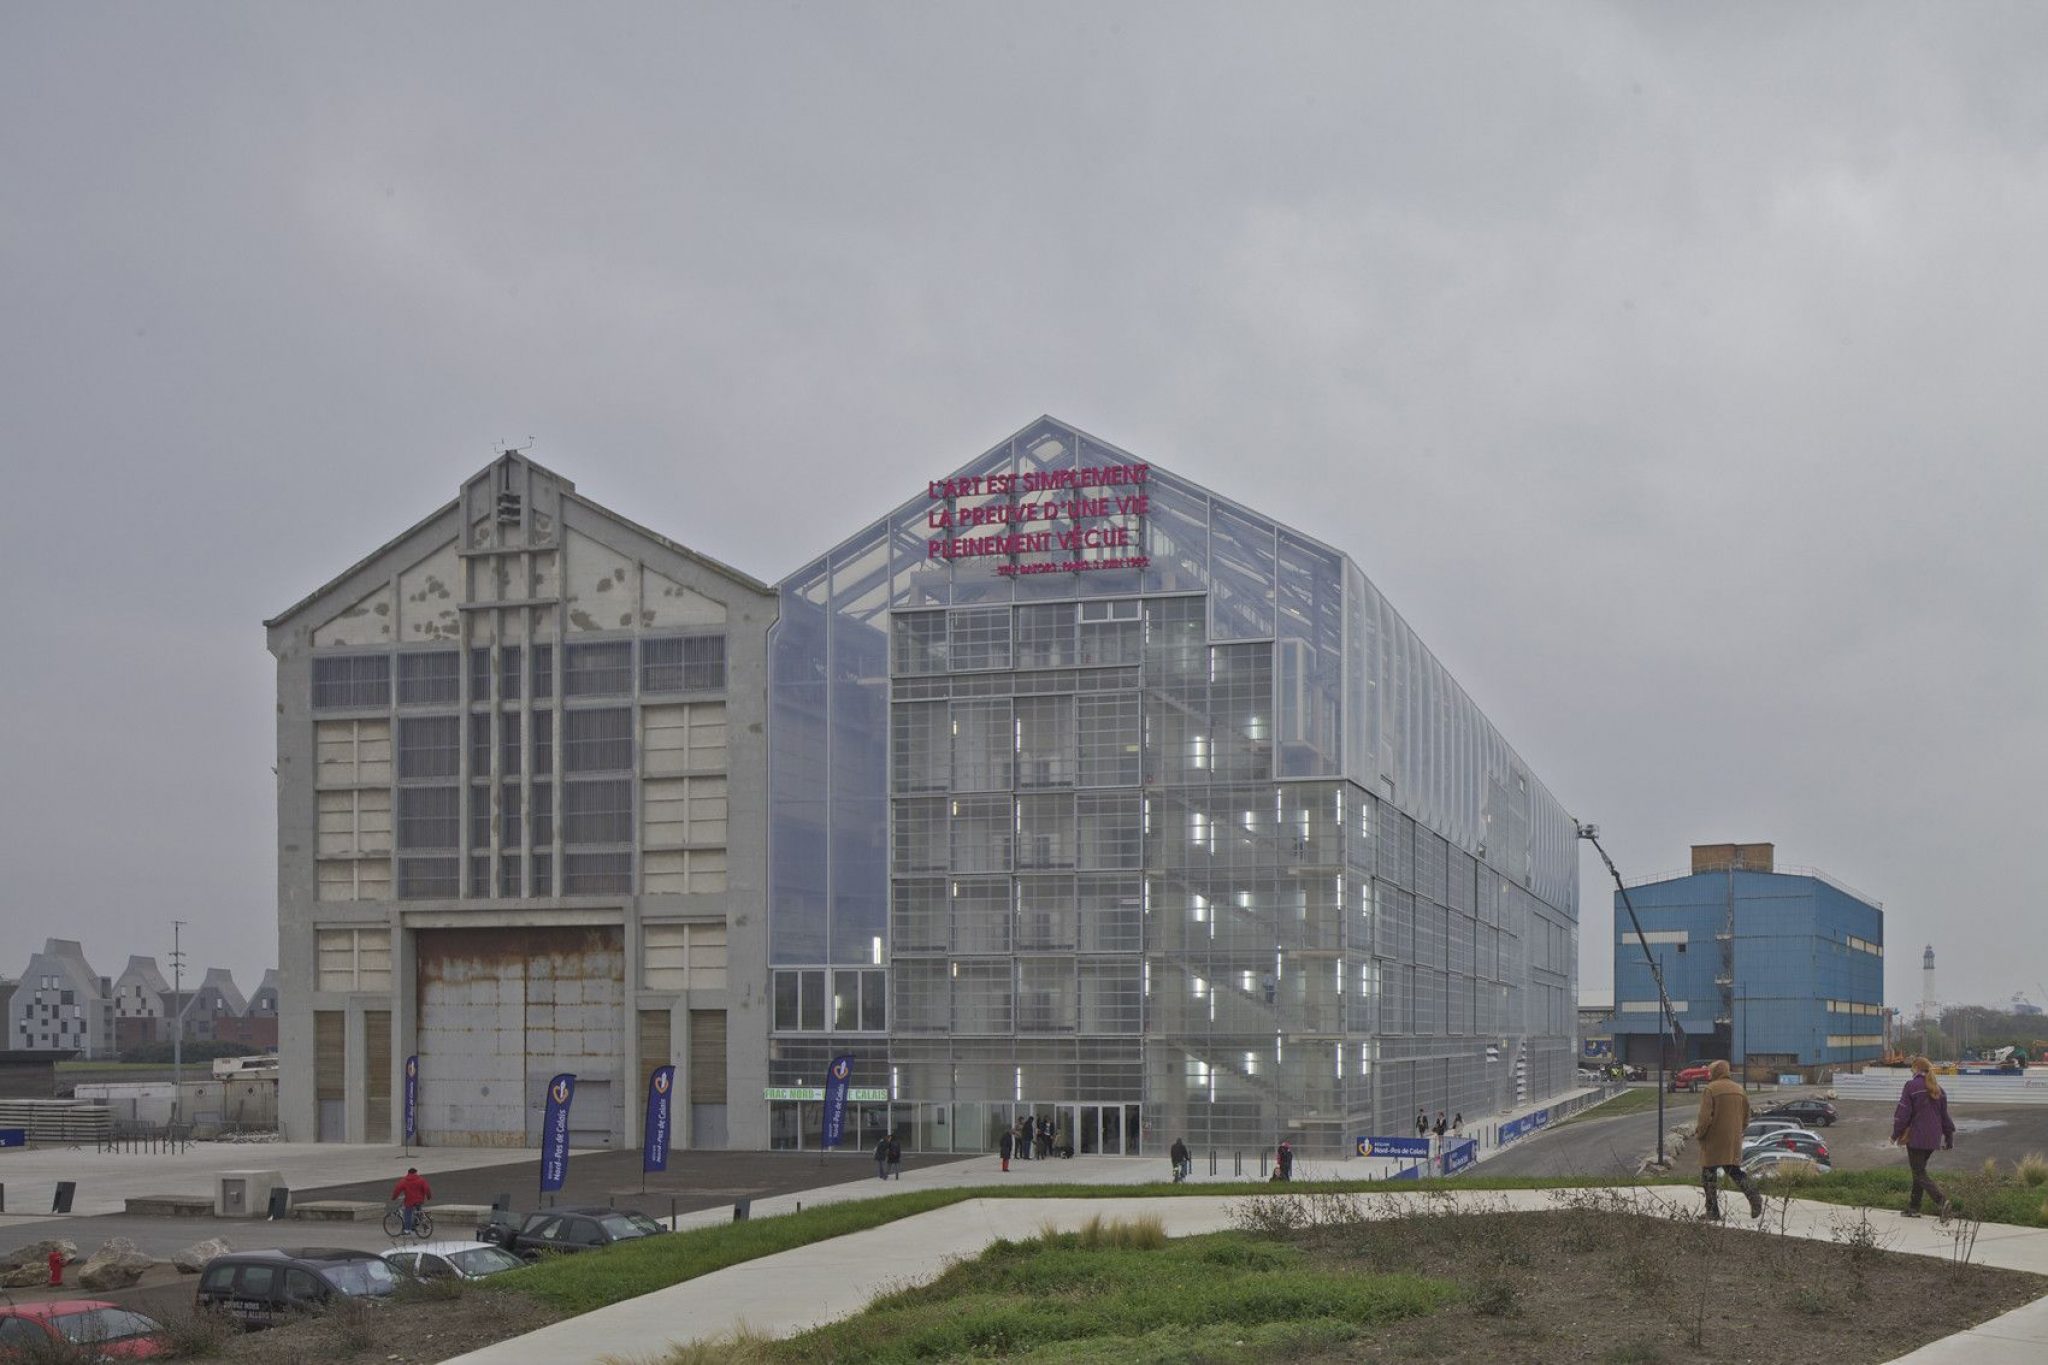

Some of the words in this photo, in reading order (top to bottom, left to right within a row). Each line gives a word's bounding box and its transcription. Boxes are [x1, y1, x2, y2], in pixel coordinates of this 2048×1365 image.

[929, 476, 981, 499] L'ART
[986, 473, 1018, 494] EST
[1023, 463, 1149, 492] SIMPLEMENT
[928, 509, 951, 529] LA
[959, 502, 1037, 526] PREUVE
[1044, 497, 1110, 520] D'UNE
[1117, 495, 1150, 515] VIE
[928, 532, 1051, 559] PLEINEMENT
[1057, 523, 1129, 549] VÉCUE
[790, 1088, 814, 1099] NORD
[855, 1089, 888, 1100] CALAIS
[658, 1098, 667, 1119] Calais
[556, 1109, 566, 1133] Calais
[657, 1120, 666, 1129] de
[555, 1133, 564, 1143] de
[1409, 1147, 1427, 1155] Calais
